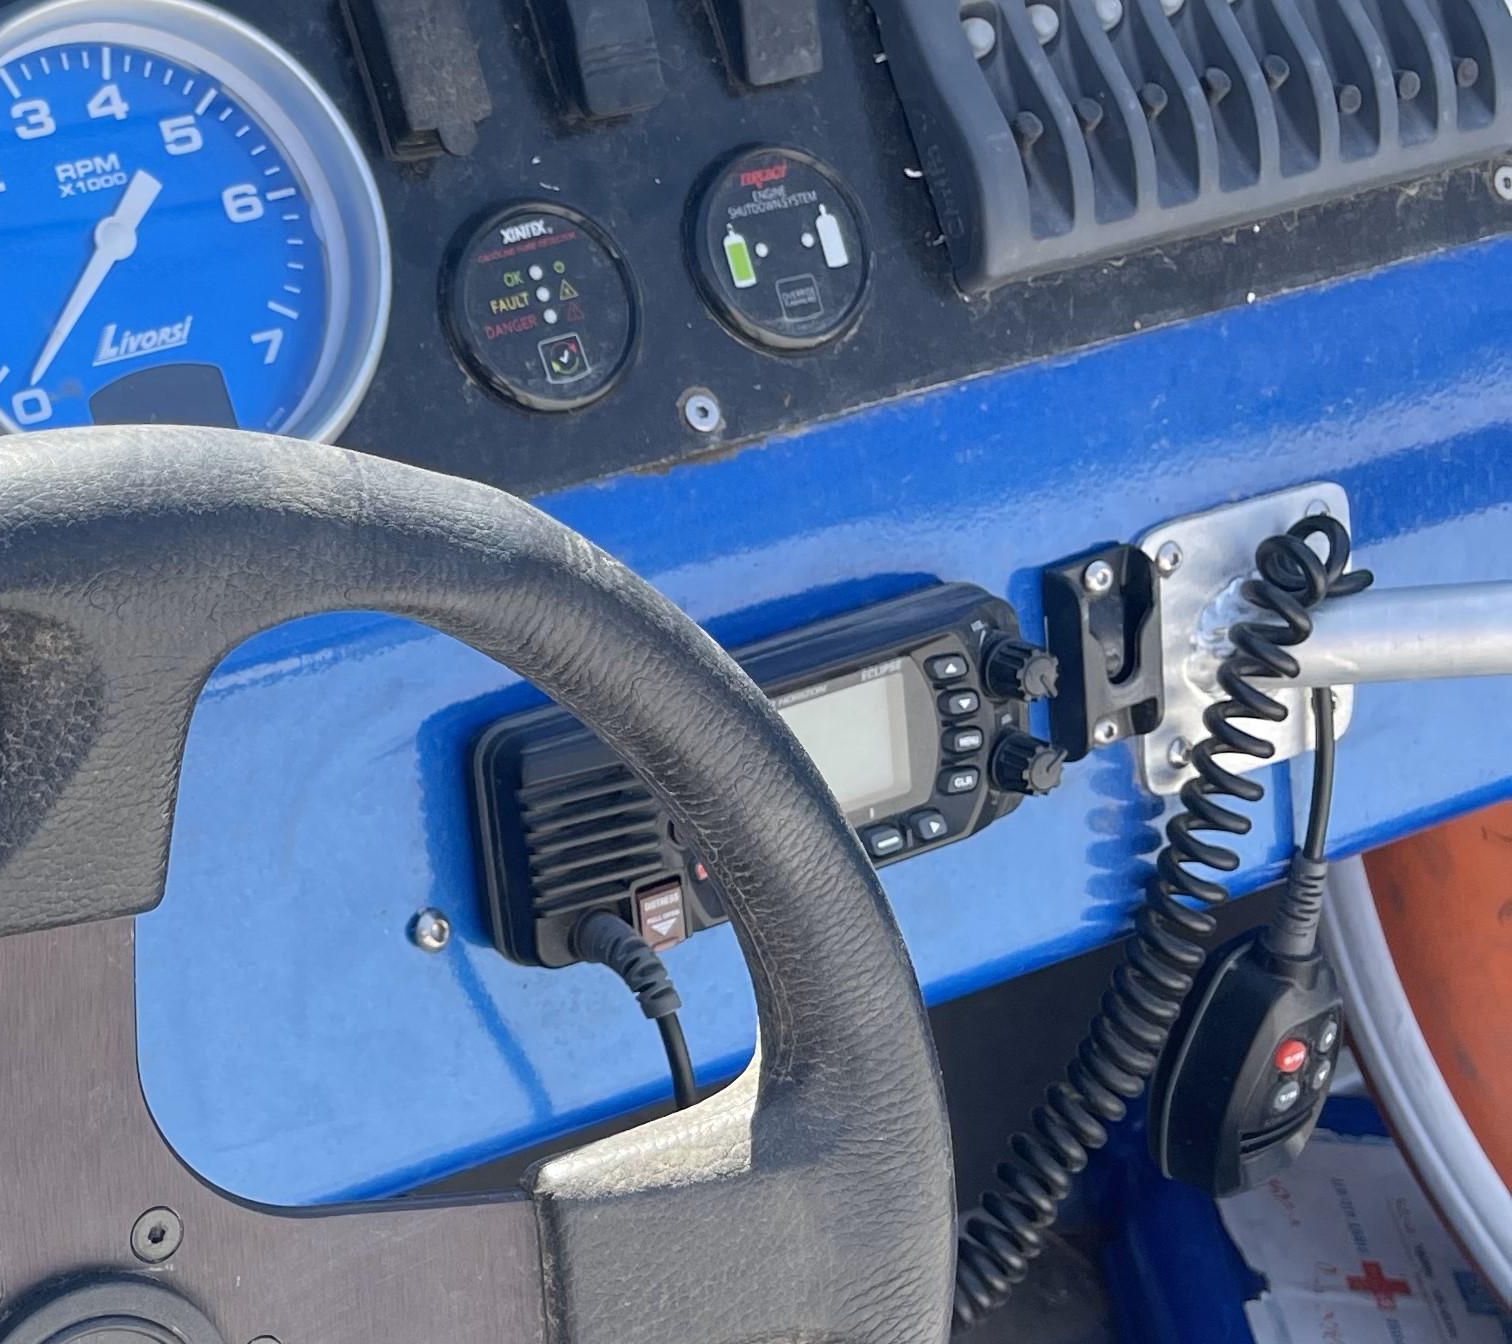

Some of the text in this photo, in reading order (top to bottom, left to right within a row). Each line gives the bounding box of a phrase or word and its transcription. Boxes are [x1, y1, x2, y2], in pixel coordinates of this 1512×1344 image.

[87, 85, 130, 120] 4
[10, 99, 57, 139] 3
[159, 115, 203, 156] 5
[56, 153, 121, 183] RPM
[58, 171, 128, 199] X1000
[221, 183, 265, 223] 6
[728, 190, 818, 219] SHUTDOWN SYSTEM
[503, 270, 524, 287] OK
[489, 291, 529, 314] FAULT
[485, 314, 537, 340] DANGER
[250, 329, 284, 364] 7
[11, 388, 53, 426] 0
